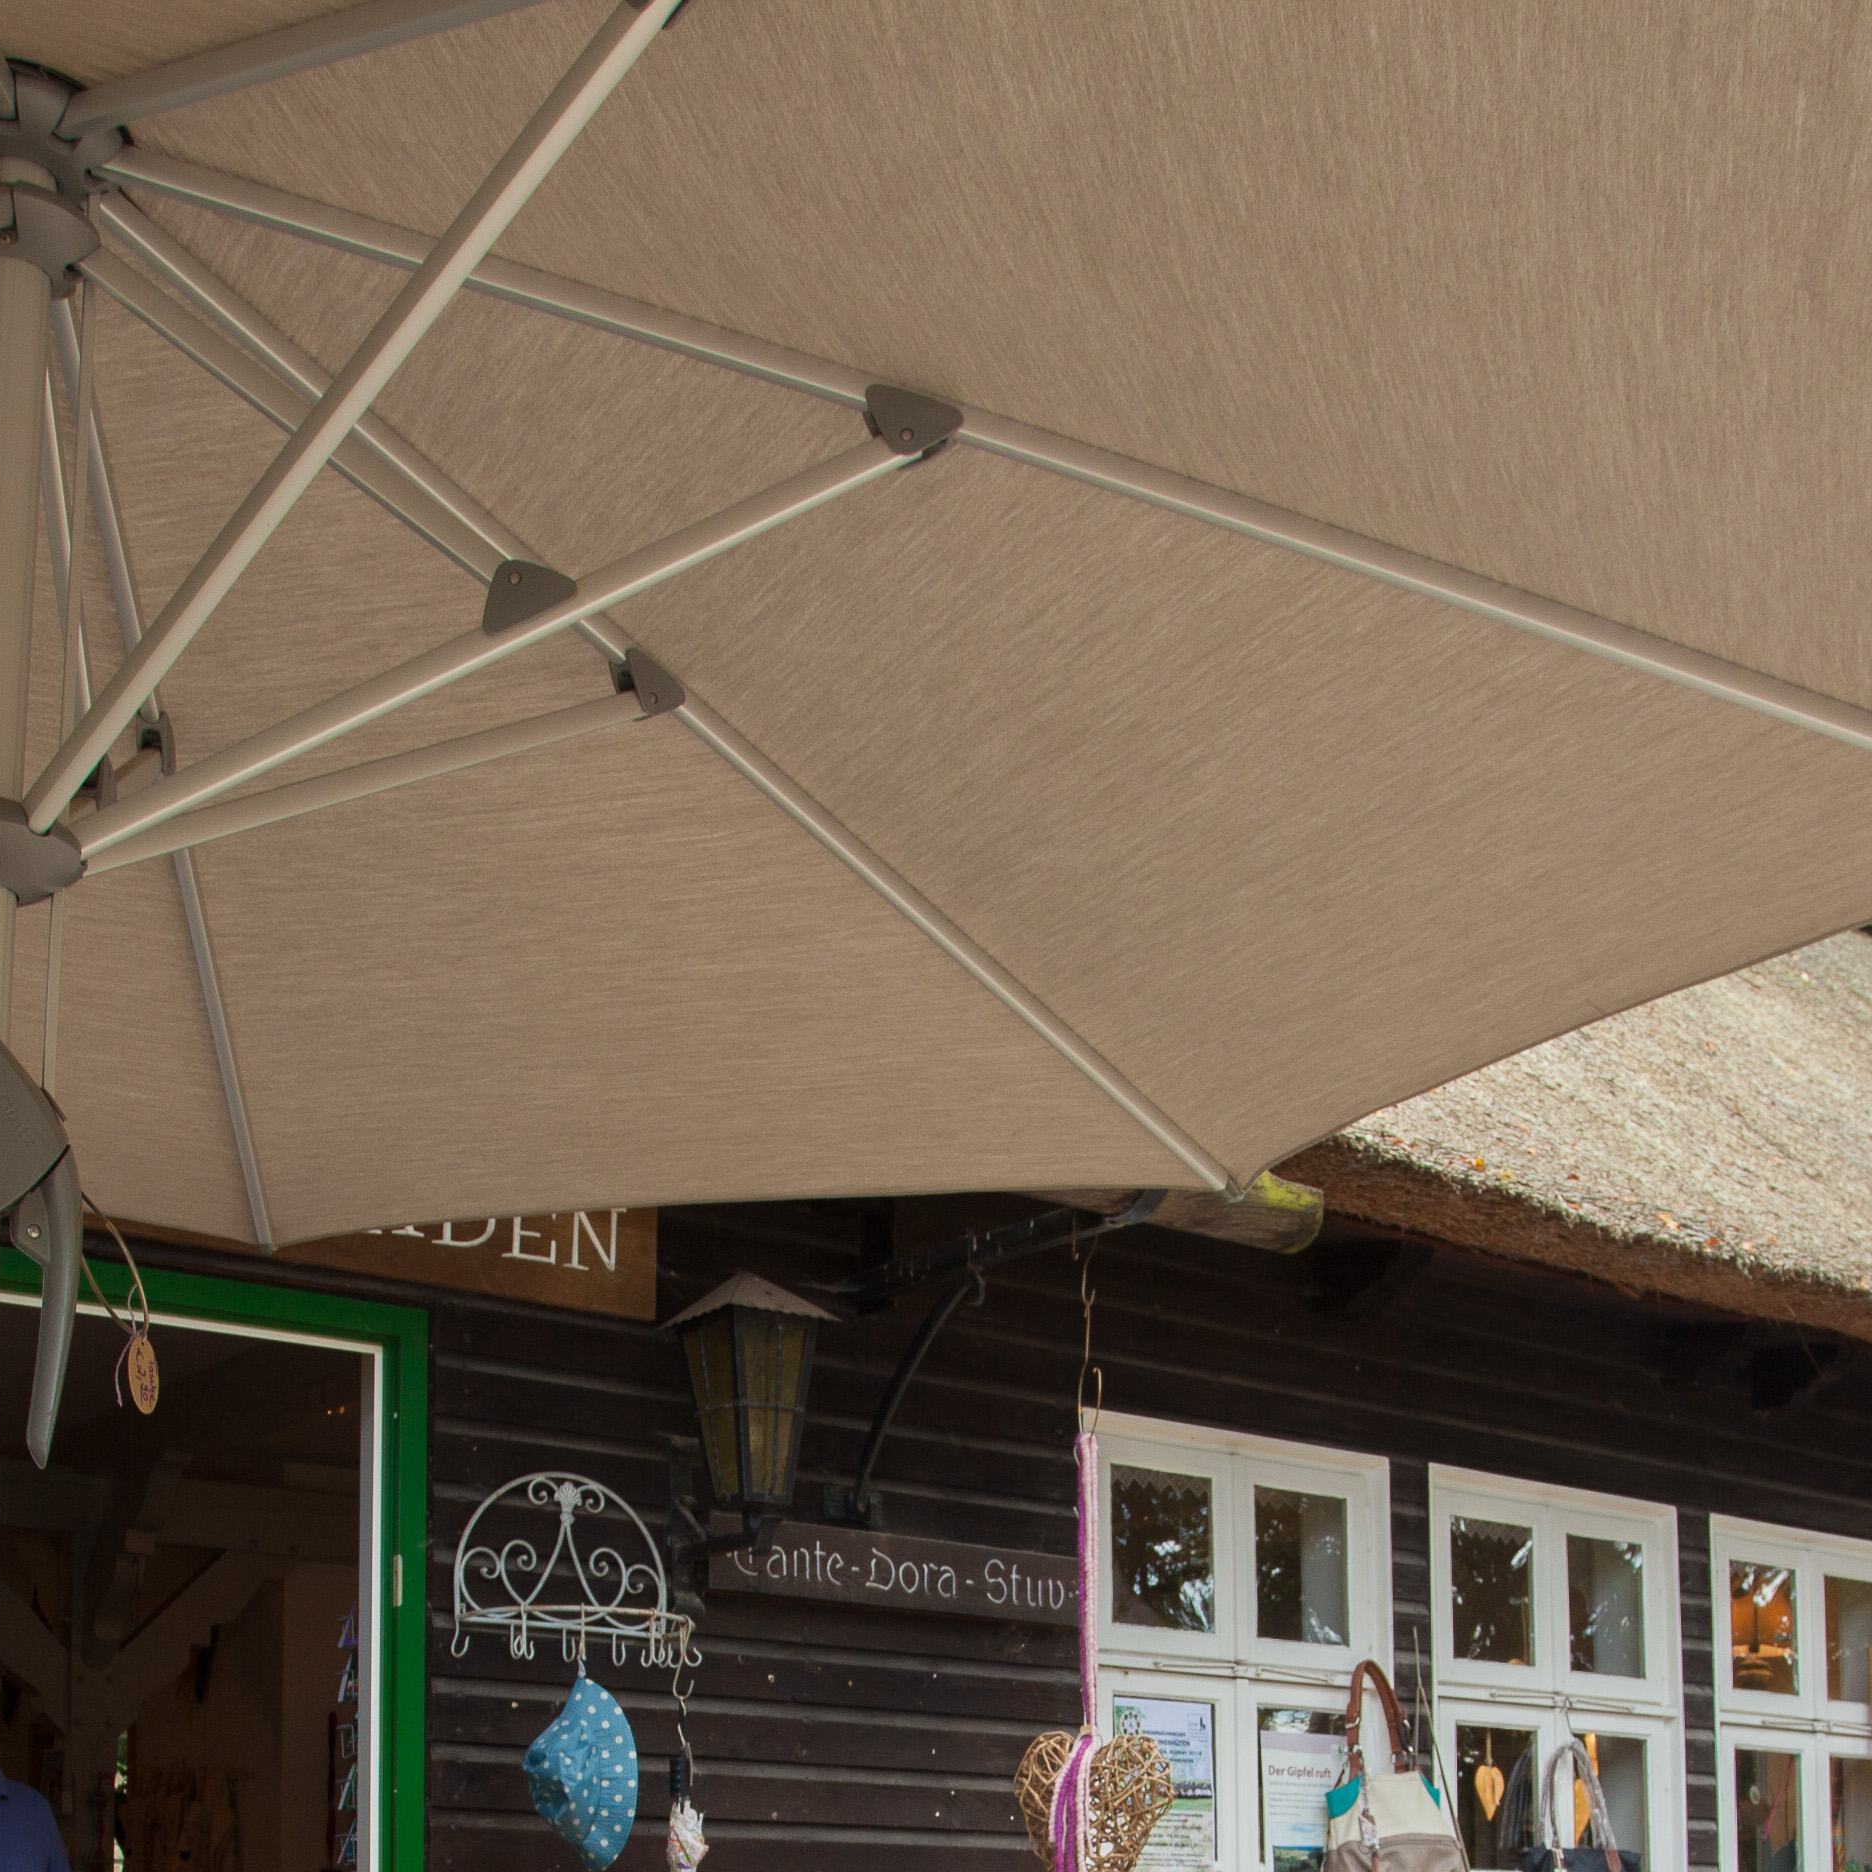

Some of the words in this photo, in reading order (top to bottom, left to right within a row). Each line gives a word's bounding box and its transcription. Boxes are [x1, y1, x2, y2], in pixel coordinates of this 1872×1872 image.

[367, 1207, 627, 1272] DEN
[1268, 1764, 1285, 1776] Der
[1287, 1765, 1314, 1780] Gipfel
[1315, 1767, 1331, 1779] ruft
